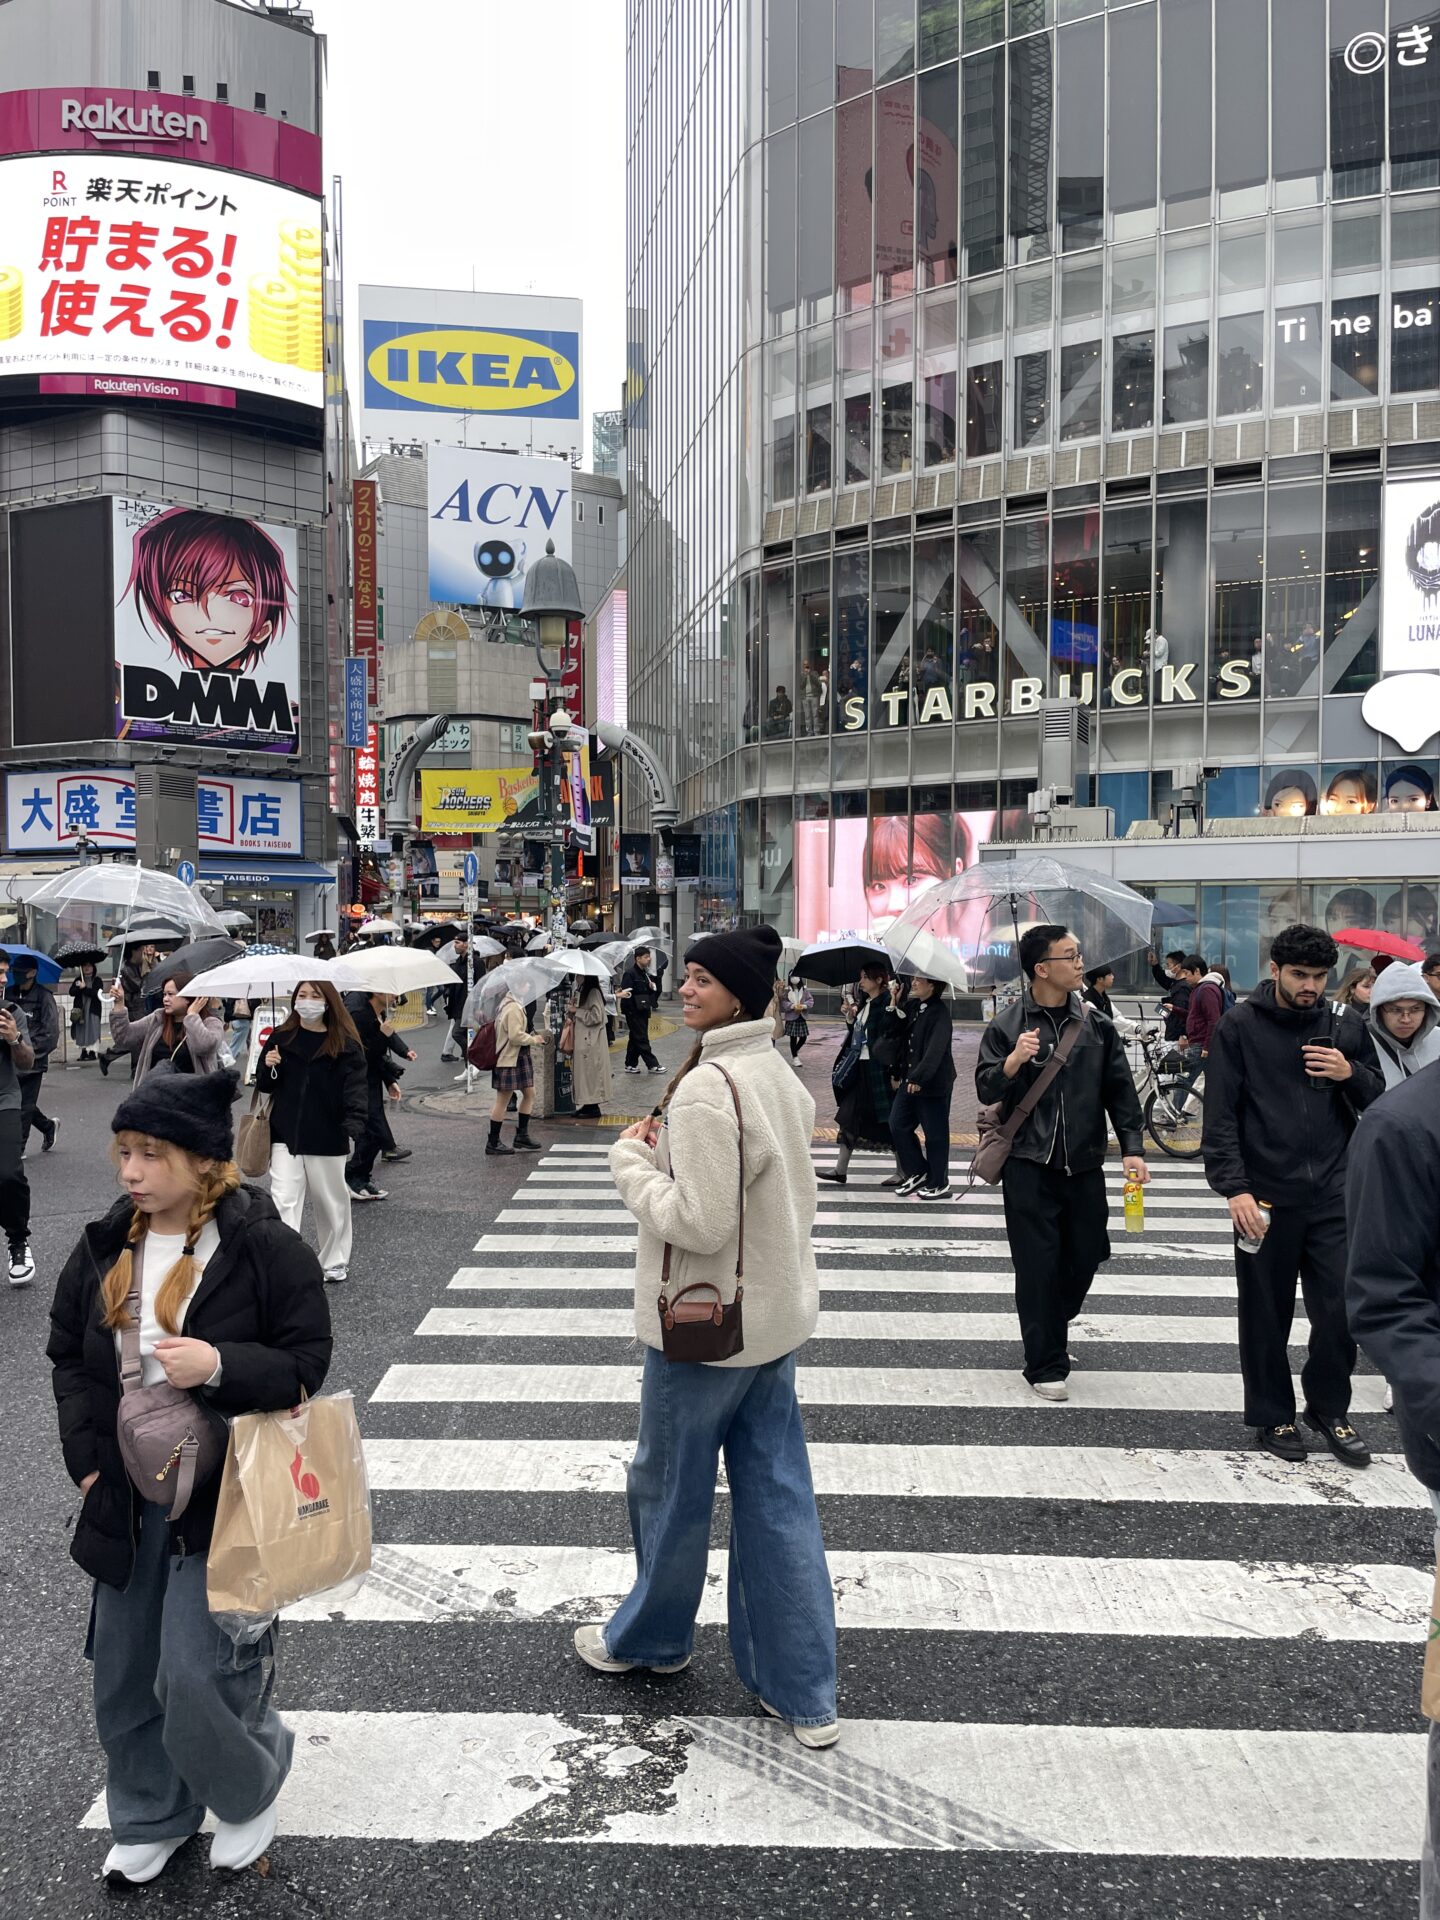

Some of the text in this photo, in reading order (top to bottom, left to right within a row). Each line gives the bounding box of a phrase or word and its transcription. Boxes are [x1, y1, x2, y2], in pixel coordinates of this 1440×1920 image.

[61, 97, 208, 142] Rakuten
[43, 196, 77, 207] POINT
[86, 177, 238, 216] 楽天ポイント
[94, 379, 179, 395] Rakuten Vision
[387, 347, 562, 391] IKEA
[118, 500, 164, 518] コードギアス
[431, 479, 569, 530] ACN
[357, 486, 373, 609] クスリのことなら
[122, 664, 295, 734] DMM
[350, 663, 364, 742] 大盛堂商事ビル
[844, 659, 1252, 730] STARBUCKS
[240, 839, 292, 849] BOOKS TAISEIDO
[222, 874, 270, 882] TAISEIDO
